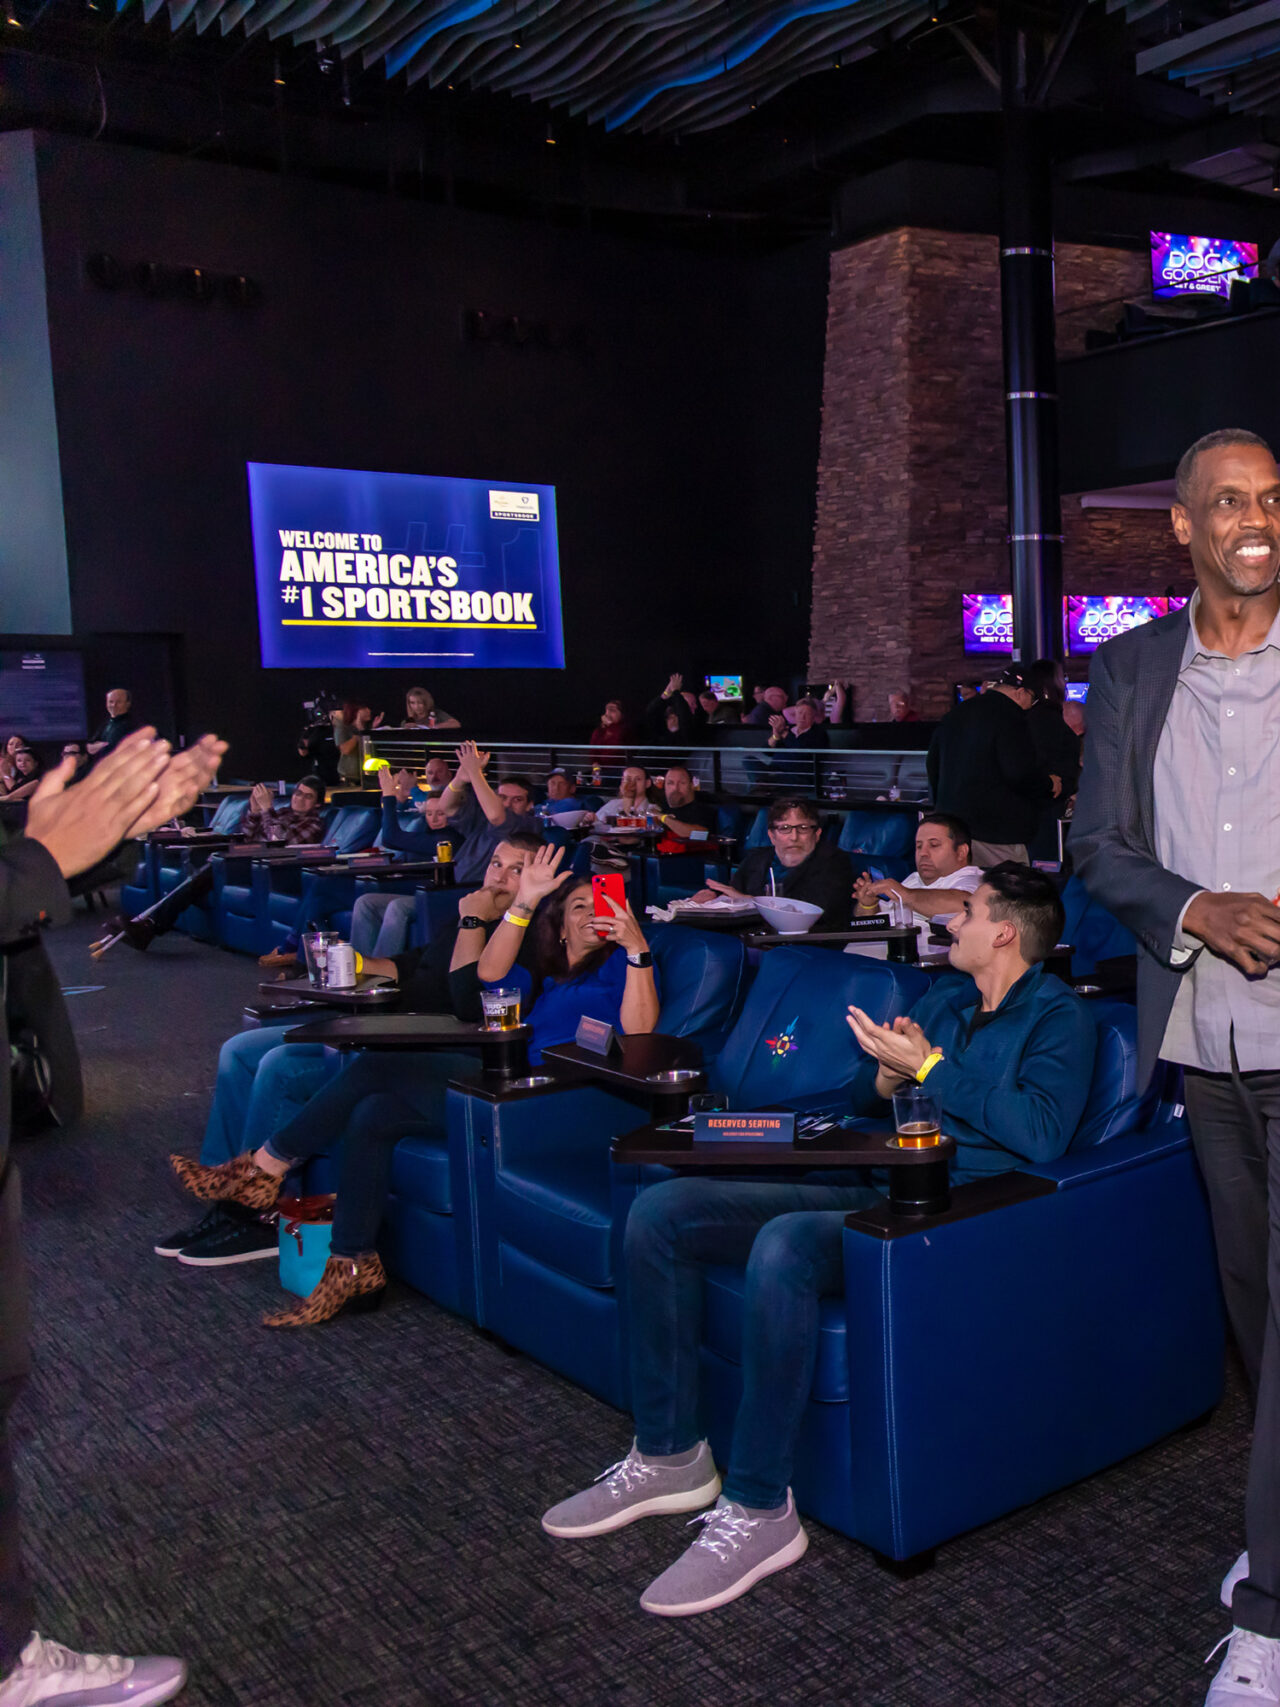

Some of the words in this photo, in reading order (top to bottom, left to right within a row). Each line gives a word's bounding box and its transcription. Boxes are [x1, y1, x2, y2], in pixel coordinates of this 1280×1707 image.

[1169, 251, 1221, 270] DOC
[279, 530, 359, 551] WELCOME
[361, 534, 383, 551] TO
[280, 550, 459, 587] AMERICA'S
[281, 585, 314, 618] #1
[321, 586, 536, 622] SPORTSBOOK
[850, 919, 885, 927] RESERVED
[708, 1119, 746, 1128] RESERVED
[748, 1119, 780, 1128] SEATING
